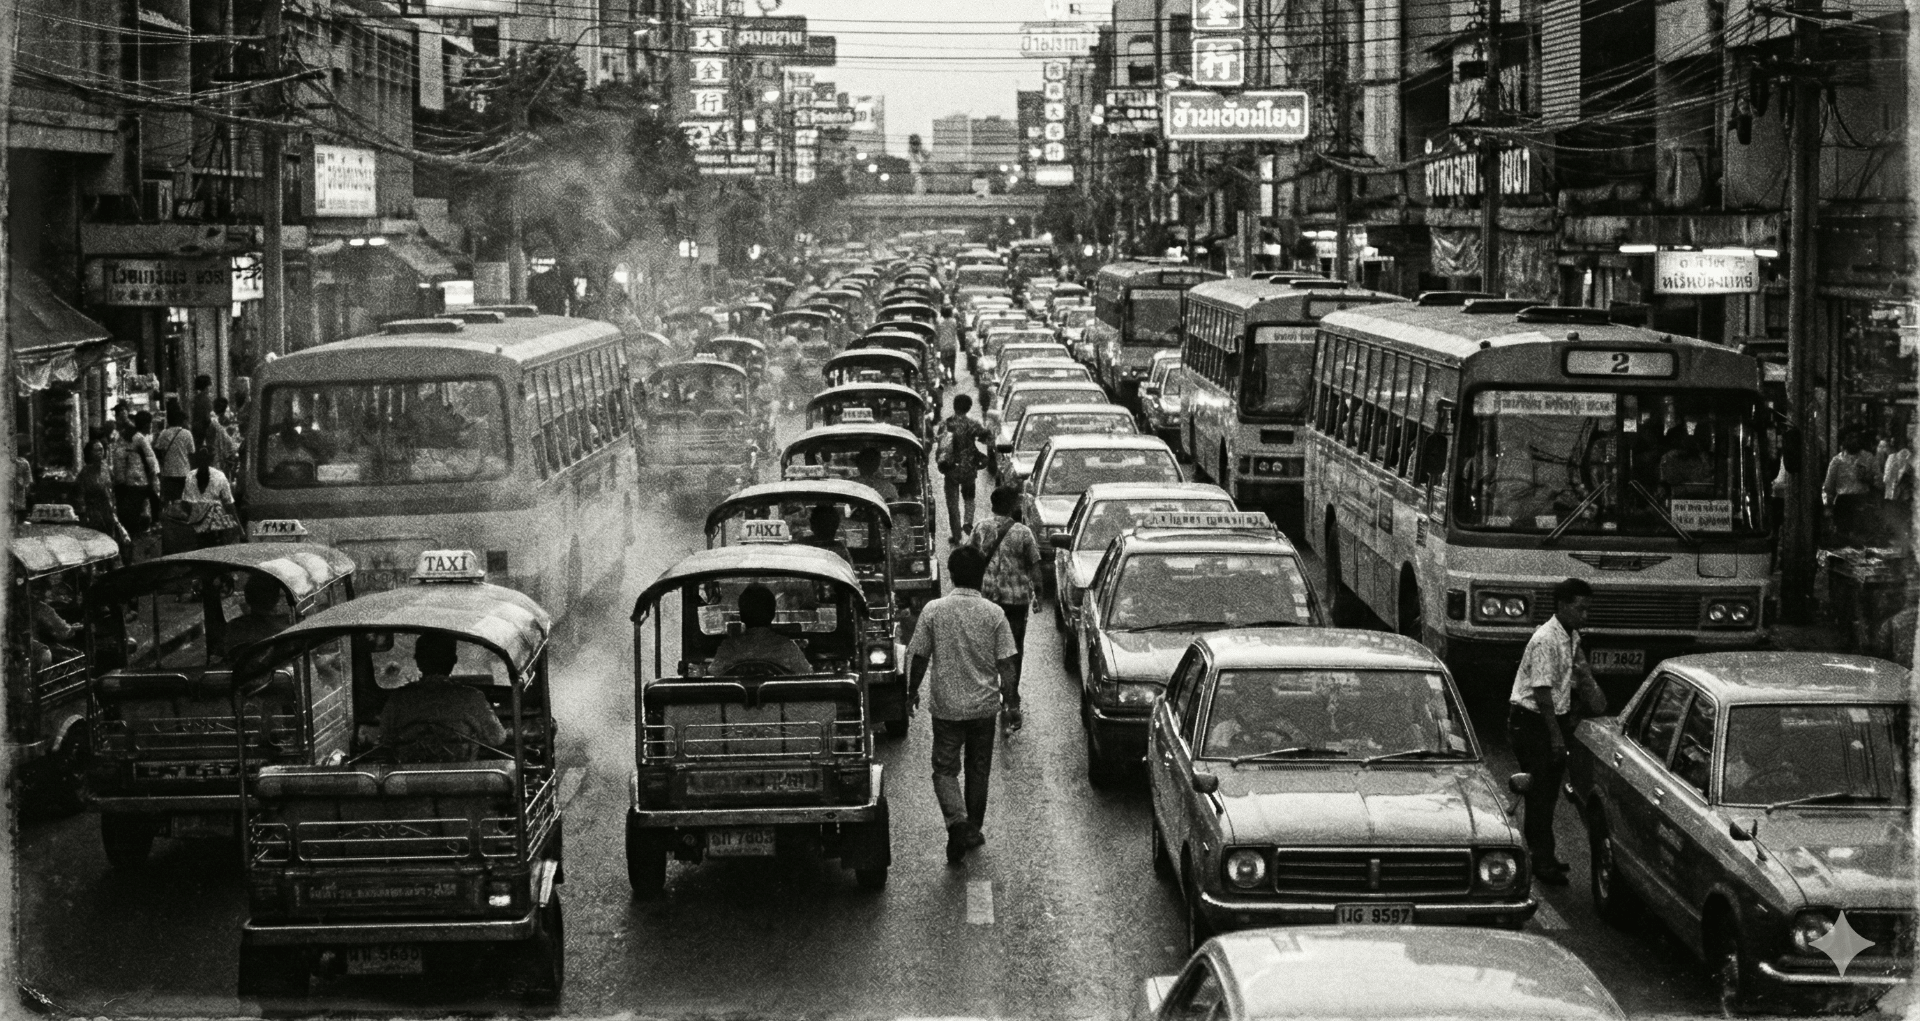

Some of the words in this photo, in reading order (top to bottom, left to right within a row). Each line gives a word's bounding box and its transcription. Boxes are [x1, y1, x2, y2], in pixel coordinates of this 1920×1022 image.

[1612, 353, 1630, 373] 2
[424, 556, 468, 571] TAXI
[1371, 908, 1410, 924] 9597
